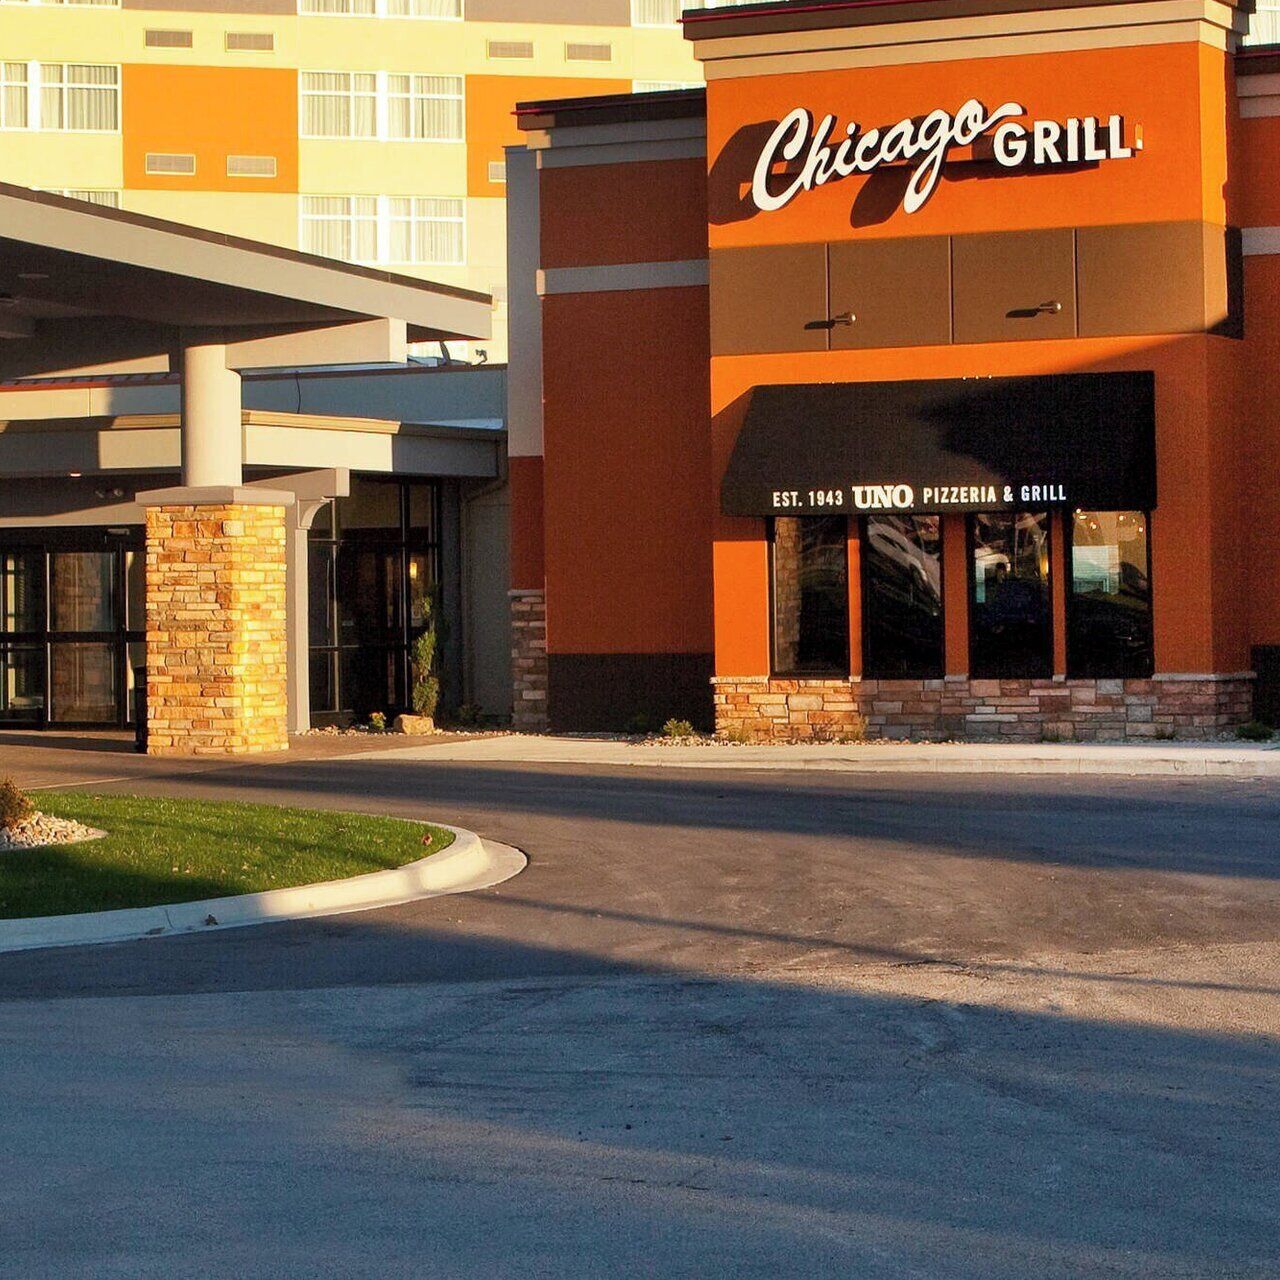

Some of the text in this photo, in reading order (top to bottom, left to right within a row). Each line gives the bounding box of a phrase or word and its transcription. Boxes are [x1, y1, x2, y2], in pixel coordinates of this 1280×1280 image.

[752, 99, 1132, 214] Chicago GRILL
[773, 484, 1067, 508] EST. 1943 UNO PIZZERIA & GRILL
